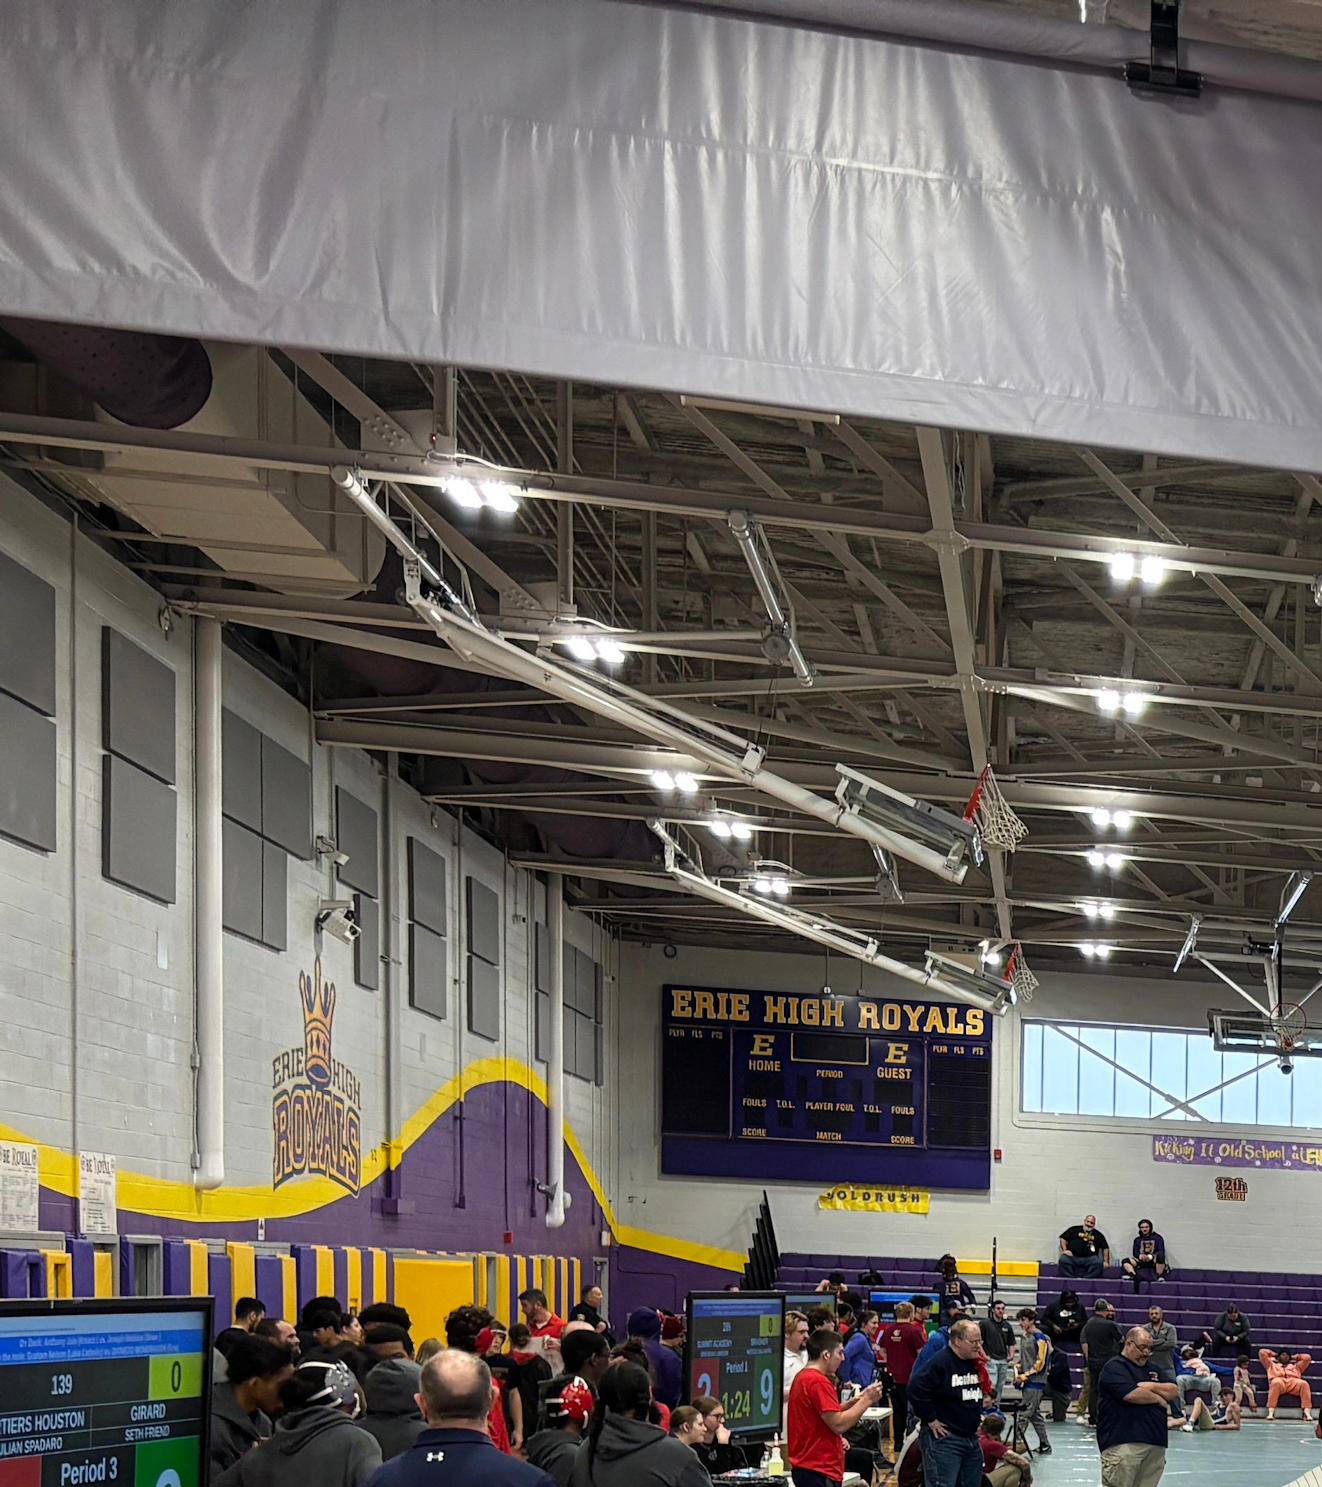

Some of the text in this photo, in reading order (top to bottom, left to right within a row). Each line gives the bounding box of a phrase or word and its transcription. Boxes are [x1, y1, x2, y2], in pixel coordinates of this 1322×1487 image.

[671, 989, 984, 1036] ERIE HIGH ROYALS
[750, 1034, 775, 1057] E
[884, 1042, 909, 1064] E
[748, 1059, 781, 1072] HOME
[876, 1066, 913, 1080] GUEST
[272, 1047, 362, 1111] ERIE HIGH
[816, 1069, 844, 1079] PERIOD
[742, 1097, 767, 1108] FOULS
[776, 1099, 796, 1109] T.O.L.
[805, 1101, 856, 1113] PLAYER FOUL
[863, 1104, 883, 1114] T.O.L.
[891, 1105, 916, 1115] FOULS
[742, 1127, 767, 1137] SCORE
[816, 1131, 842, 1141] MATCH
[890, 1135, 916, 1145] SCORE
[273, 1084, 361, 1198] ROYALS
[1154, 1140, 1195, 1162] Kicking
[1200, 1146, 1214, 1158] It
[1218, 1142, 1243, 1159] Old
[1244, 1144, 1286, 1160] School
[1215, 1177, 1248, 1193] 12th
[726, 1362, 745, 1373] Period
[51, 1374, 73, 1395] 139
[171, 1360, 182, 1393] 0
[760, 1368, 774, 1416] 9
[130, 1403, 166, 1422] GIRARD
[721, 1390, 750, 1420] 1:24
[35, 1411, 85, 1432] HOUSTON
[125, 1425, 170, 1441] SETH FRIEND
[24, 1437, 63, 1453] SPADARO
[61, 1456, 118, 1486] Period 3
